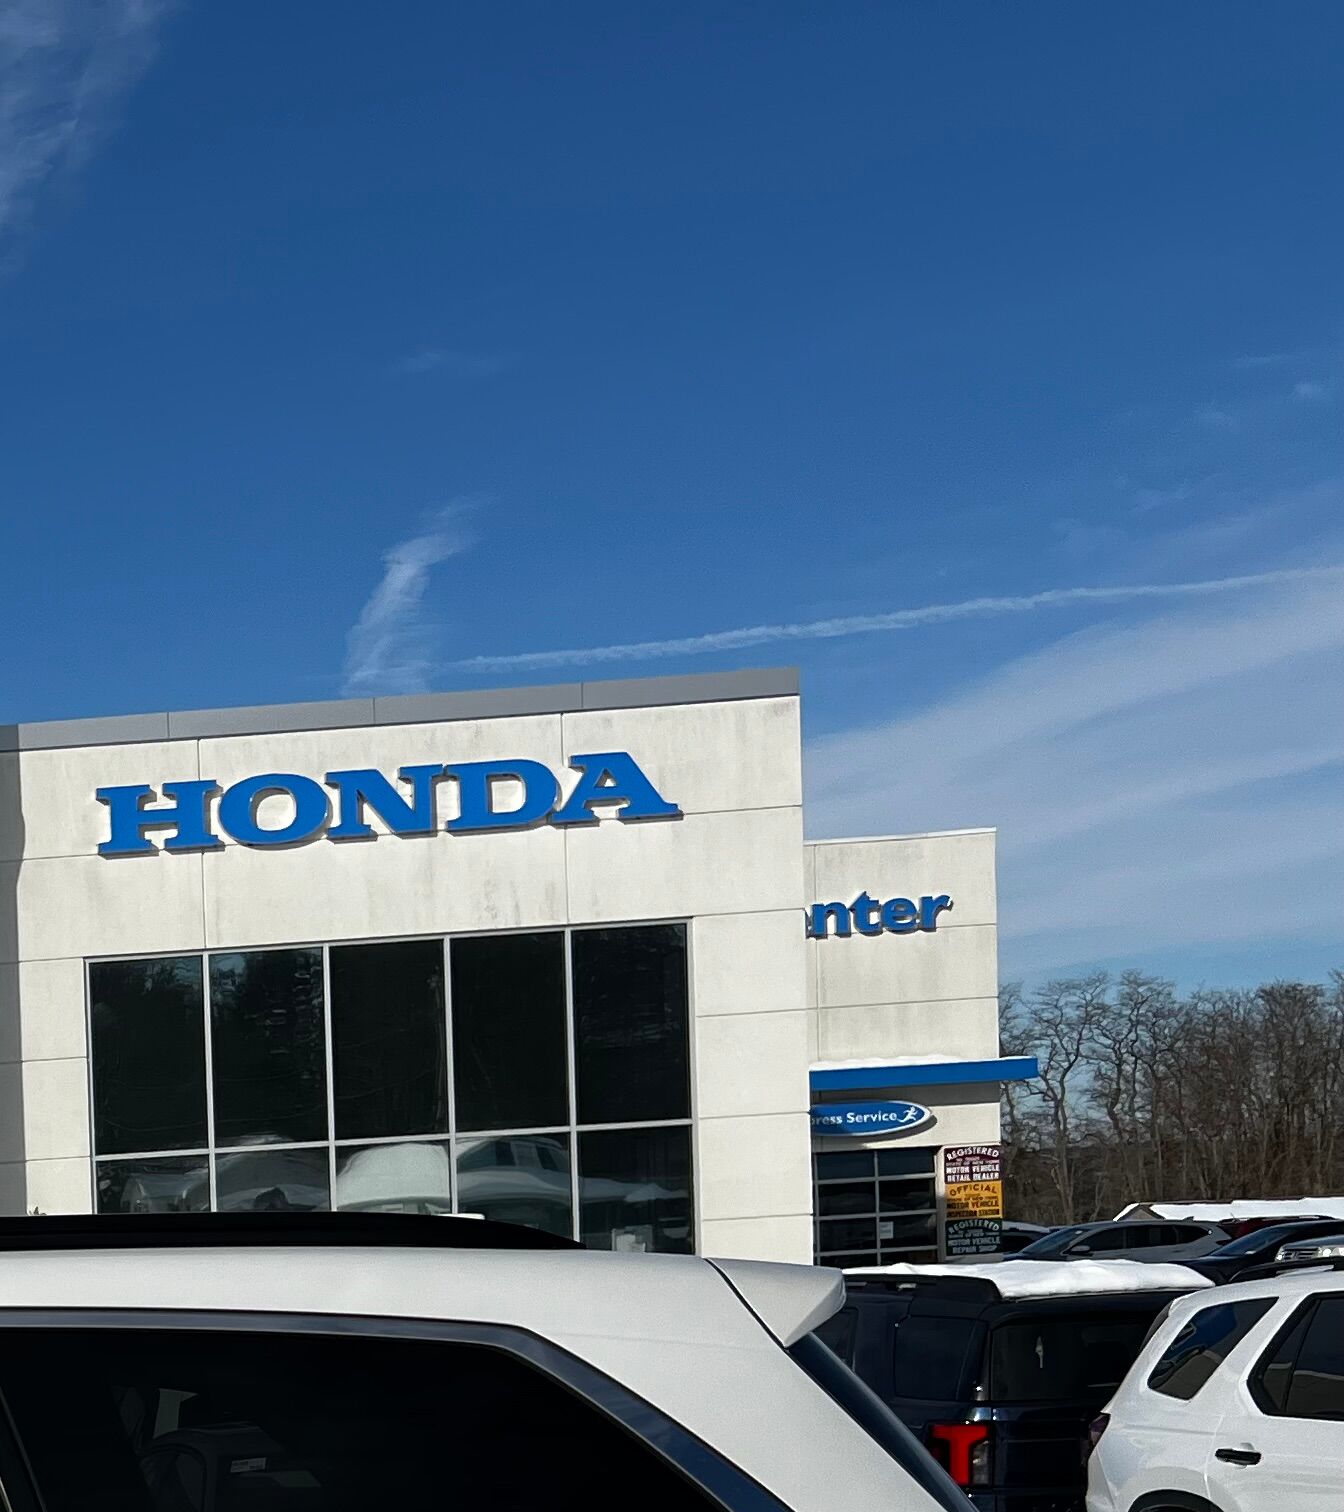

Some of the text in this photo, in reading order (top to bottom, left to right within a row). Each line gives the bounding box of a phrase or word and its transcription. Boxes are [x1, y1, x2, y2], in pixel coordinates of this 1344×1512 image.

[95, 751, 683, 856] HONDA
[805, 890, 953, 939] nter
[846, 1110, 897, 1123] Service
[946, 1146, 1000, 1161] REGISTERED
[946, 1164, 1000, 1174] MOTOR VEHICLE
[949, 1183, 997, 1196] OFFICIAL
[948, 1219, 1000, 1234] REGISTERED
